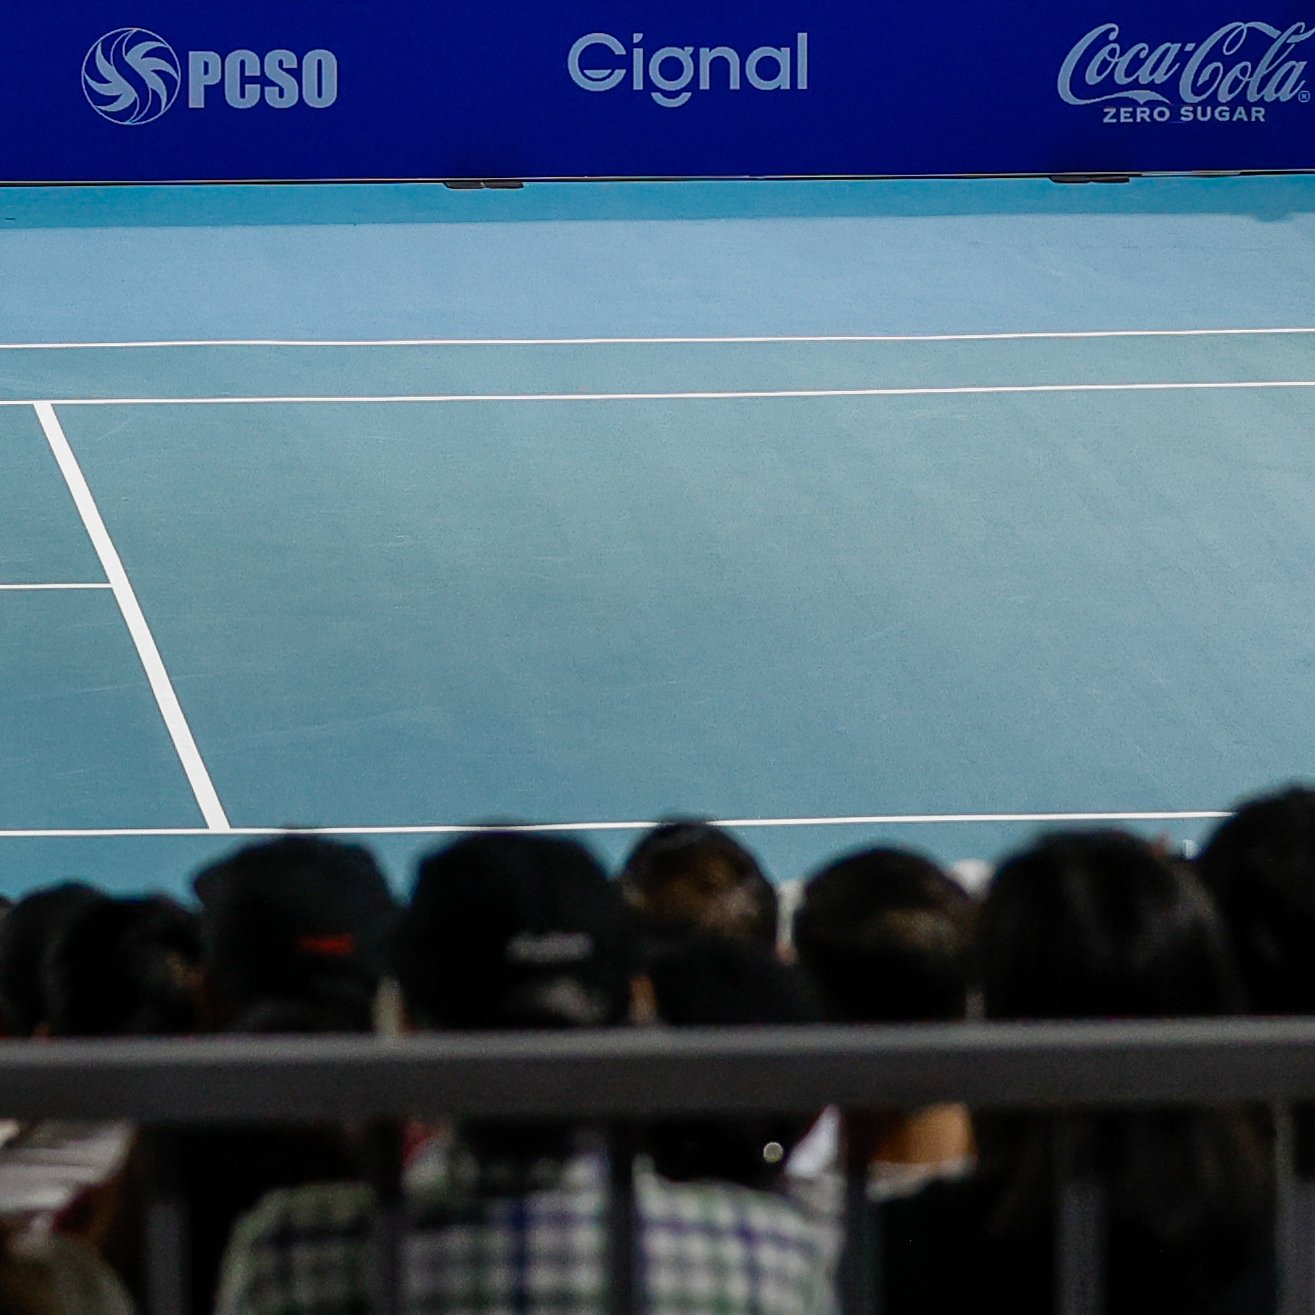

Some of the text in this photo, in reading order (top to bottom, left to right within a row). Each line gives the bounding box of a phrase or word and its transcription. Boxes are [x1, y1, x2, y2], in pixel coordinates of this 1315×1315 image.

[188, 49, 338, 109] PCSO
[567, 32, 808, 108] Cignal
[1103, 106, 1265, 123] ZERO SUGAR
